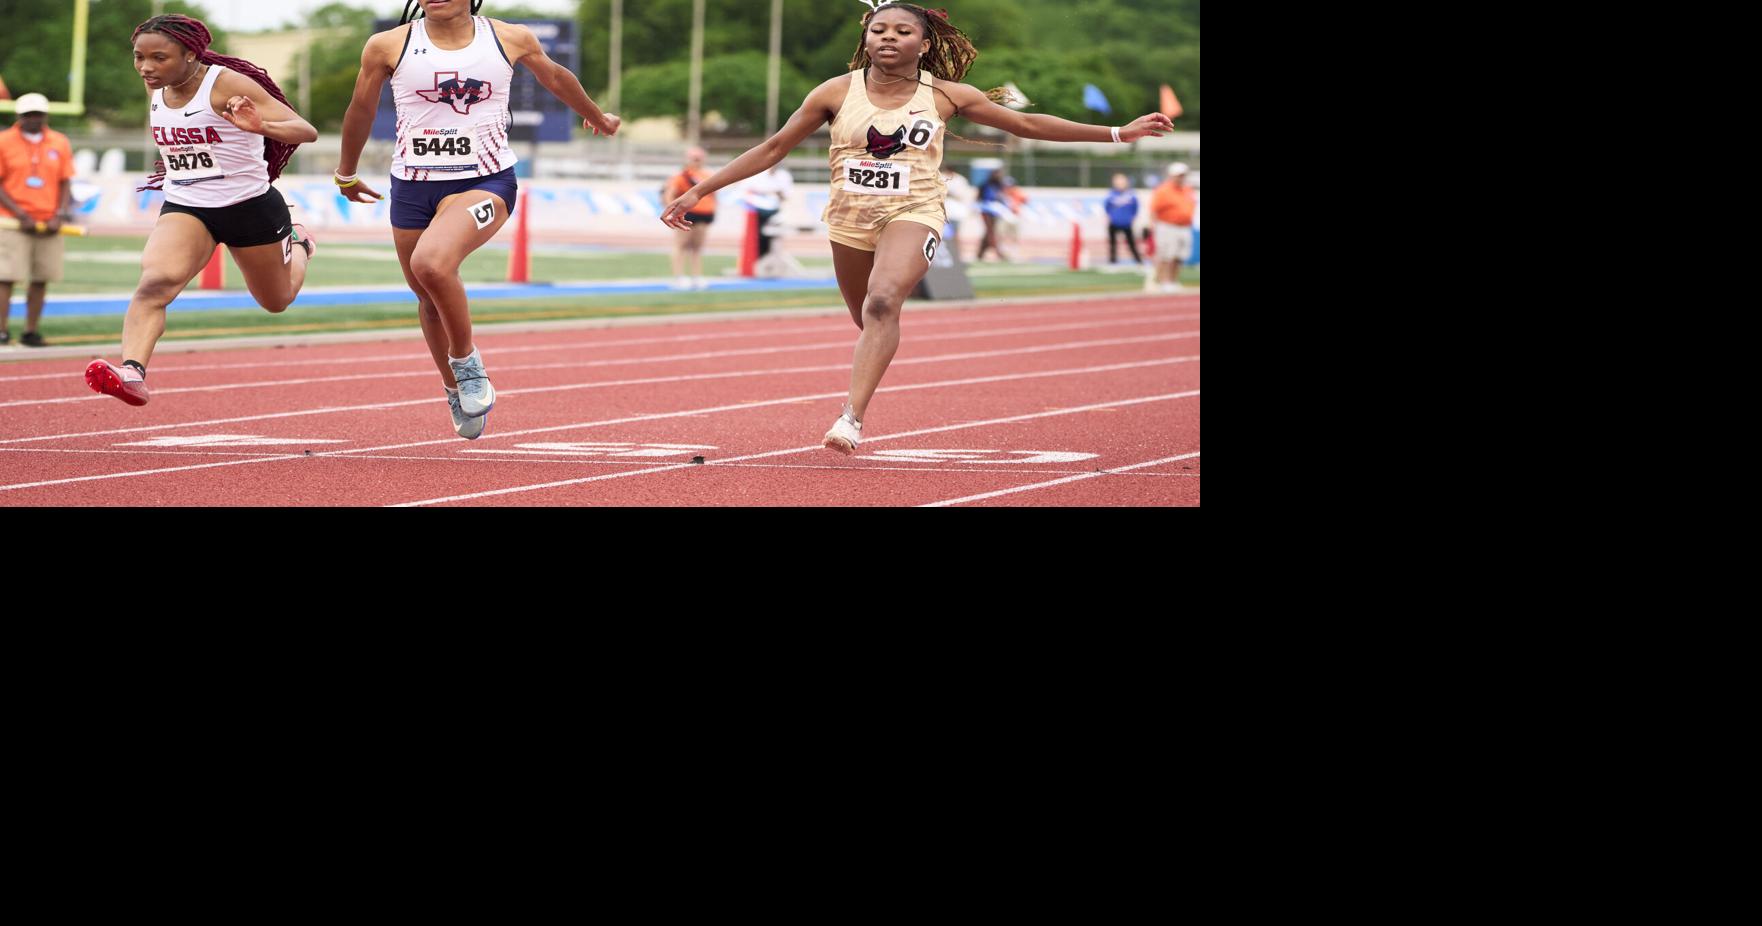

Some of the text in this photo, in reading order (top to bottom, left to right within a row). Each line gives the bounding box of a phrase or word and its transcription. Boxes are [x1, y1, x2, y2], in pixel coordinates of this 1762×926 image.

[151, 126, 223, 145] ELISSA
[908, 119, 934, 146] 6
[412, 136, 471, 156] 5443
[166, 152, 214, 171] 5476
[859, 160, 893, 169] MileSplit
[848, 168, 901, 190] 5231
[474, 203, 493, 223] 5
[925, 237, 937, 262] 6
